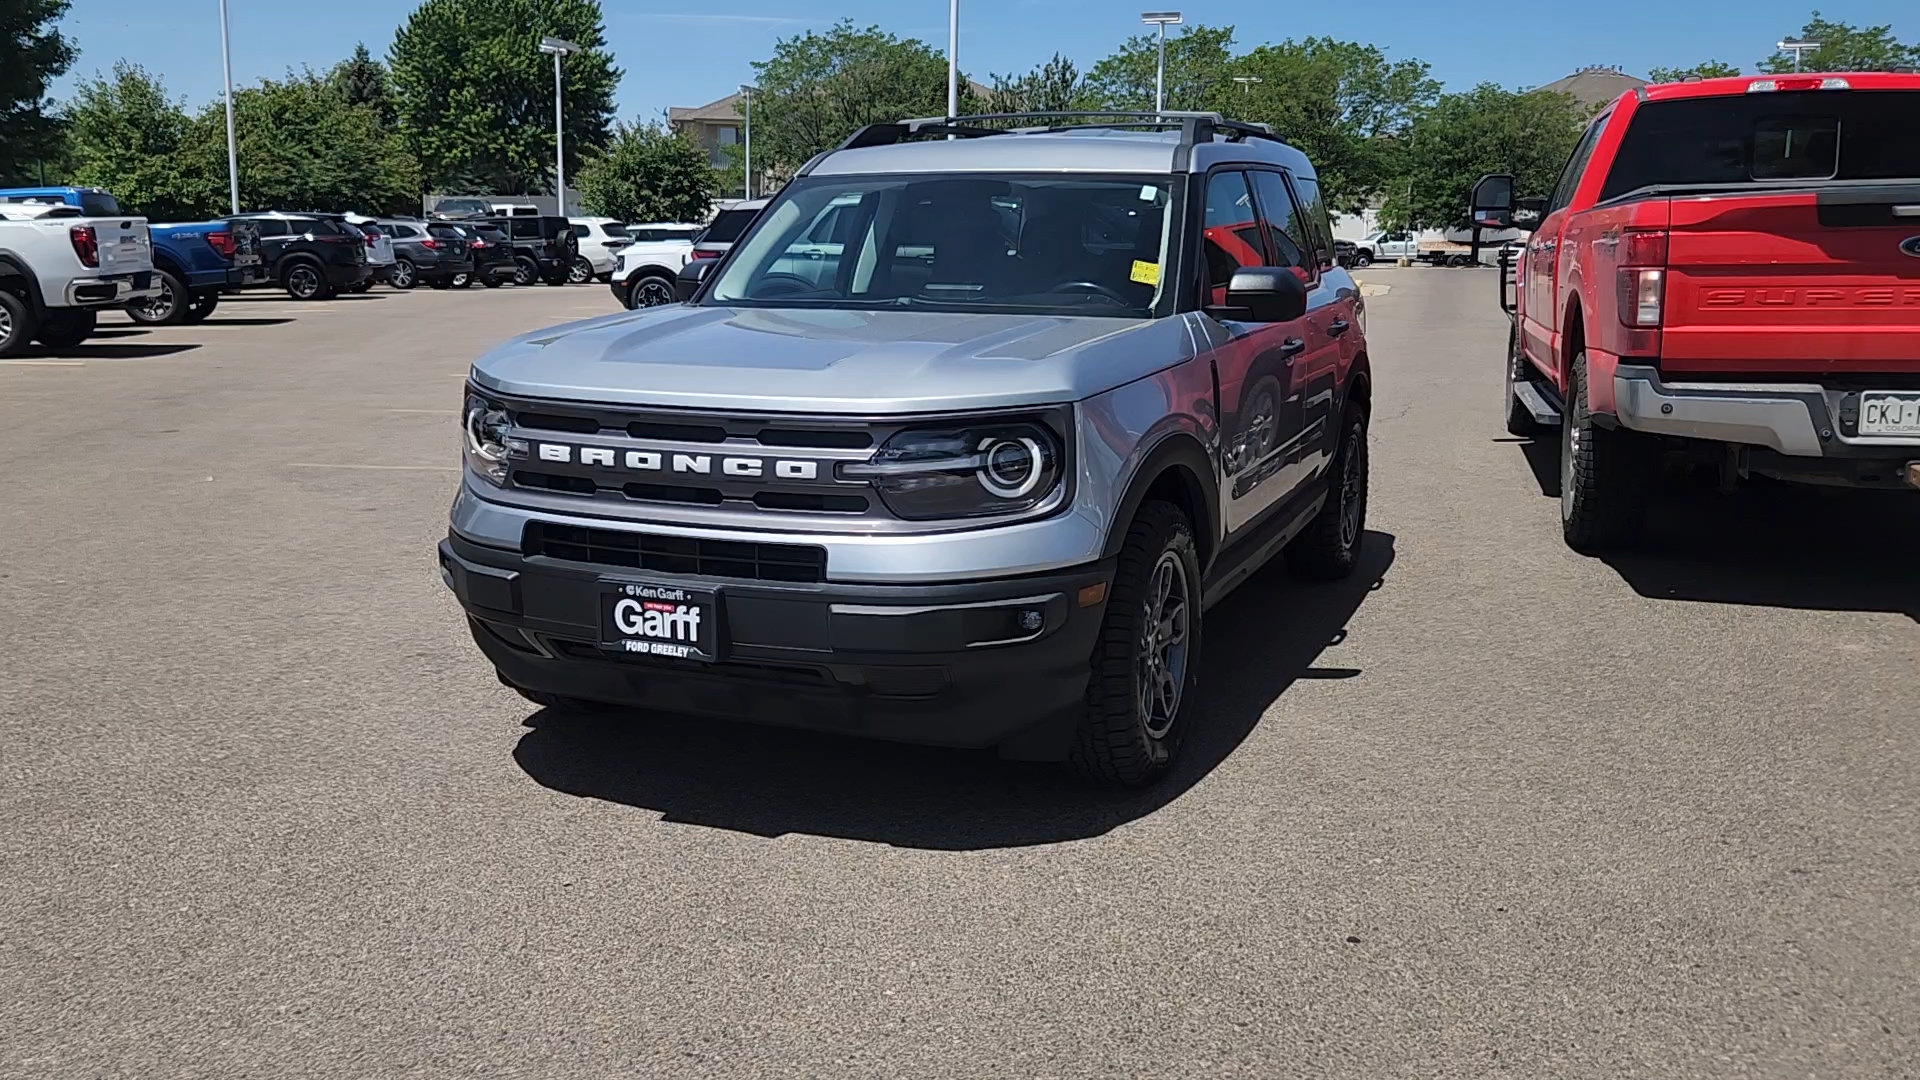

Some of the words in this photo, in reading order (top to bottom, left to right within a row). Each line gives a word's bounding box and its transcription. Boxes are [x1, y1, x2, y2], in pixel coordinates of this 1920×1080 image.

[539, 443, 818, 480] BRONCO
[635, 585, 657, 598] Ken
[657, 588, 684, 600] Garff
[614, 598, 700, 642] Garff
[625, 640, 650, 653] FORD
[650, 643, 689, 658] GREELEY
